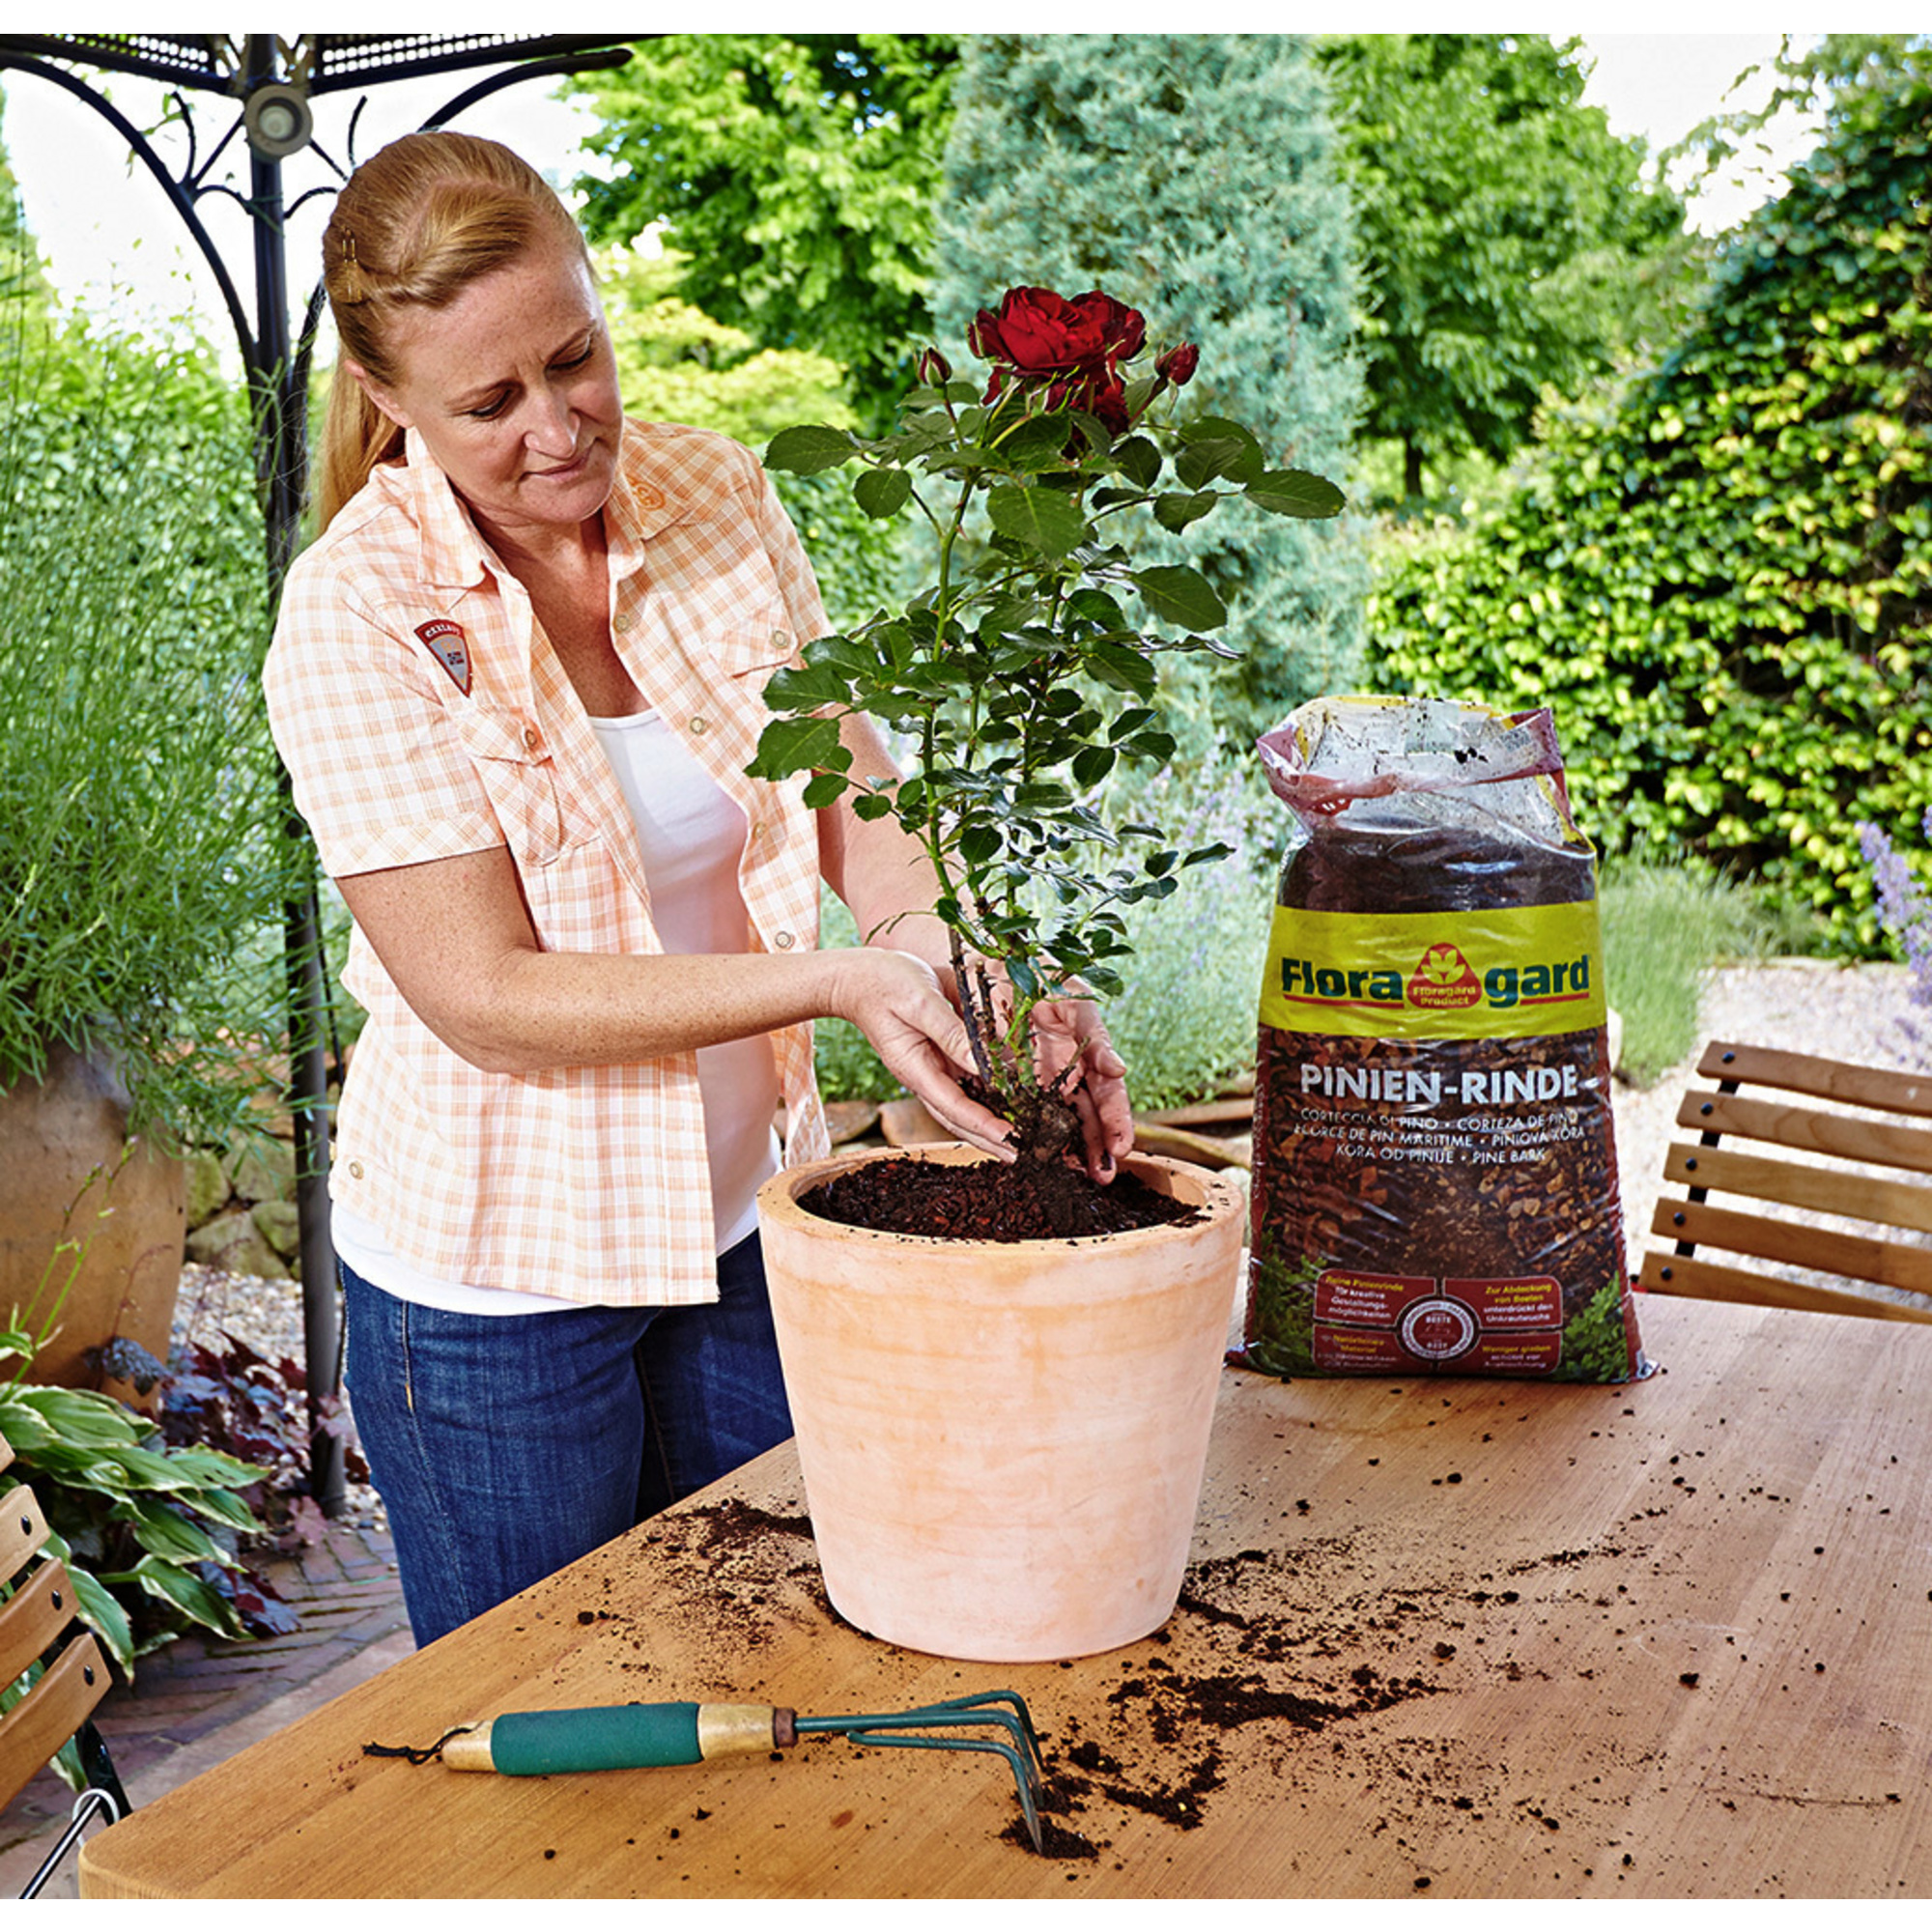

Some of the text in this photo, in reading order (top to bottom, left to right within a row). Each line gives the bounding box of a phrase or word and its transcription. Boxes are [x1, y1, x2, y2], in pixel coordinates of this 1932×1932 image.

[1282, 953, 1589, 1009] Flora gard
[1413, 985, 1476, 996] Floragard
[1421, 996, 1469, 1006] Product
[1301, 1063, 1577, 1104] PINIEN-RINDE
[1399, 1116, 1438, 1130] PINO
[1457, 1117, 1523, 1131] CORTEZA
[1527, 1115, 1546, 1128] DE
[1349, 1127, 1366, 1141] DE
[1370, 1129, 1394, 1143] PIN
[1399, 1133, 1473, 1148] MARITIME
[1336, 1143, 1376, 1158] KORA
[1379, 1147, 1405, 1160] OD
[1472, 1150, 1506, 1164] PINE
[1510, 1147, 1546, 1162] BARK
